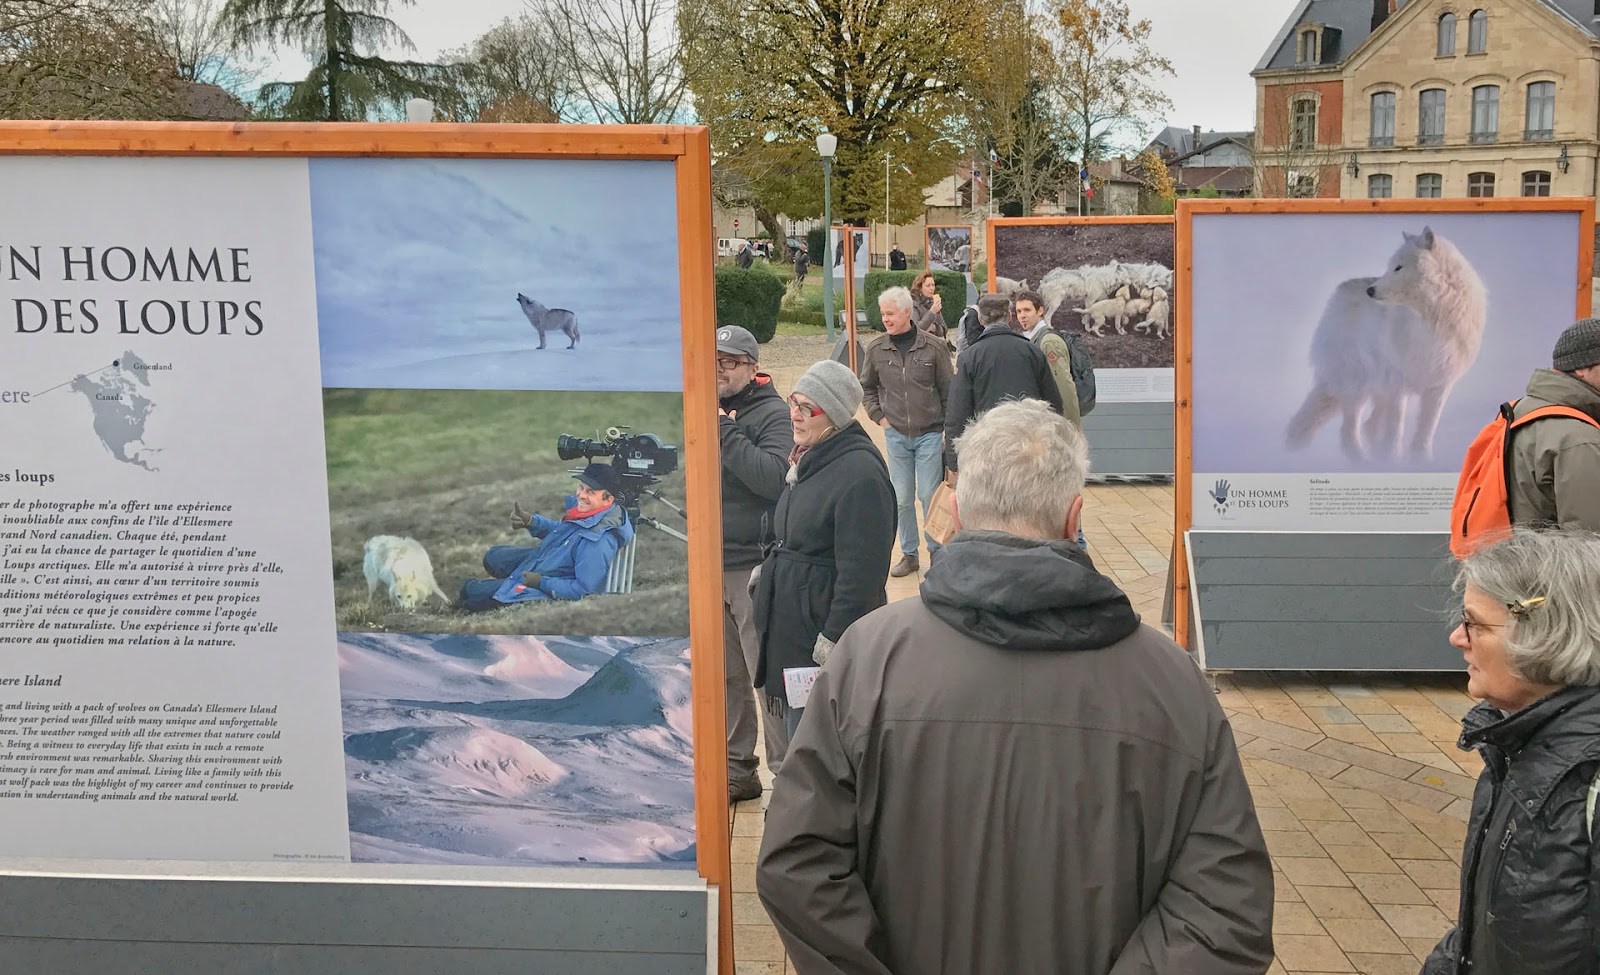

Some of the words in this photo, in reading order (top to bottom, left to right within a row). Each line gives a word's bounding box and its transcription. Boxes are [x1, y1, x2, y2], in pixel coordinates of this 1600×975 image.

[0, 246, 42, 281] N
[60, 246, 252, 283] HOMME
[12, 298, 99, 334] DES
[115, 299, 264, 336] LOUPS
[134, 362, 172, 371] Groenland
[0, 390, 30, 403] ere
[96, 392, 123, 401] Canada
[0, 473, 10, 482] es
[16, 469, 55, 486] loups
[1231, 490, 1246, 498] UN
[1249, 490, 1287, 498] HOMME
[13, 499, 26, 509] de
[27, 499, 95, 513] photographe
[98, 500, 117, 510] m’a
[121, 500, 150, 513] offert
[176, 502, 232, 514] expérience
[1239, 500, 1256, 508] DES
[1259, 500, 1289, 508] LOUPS
[3, 514, 65, 524] inoubliable
[91, 515, 129, 528] confins
[132, 515, 145, 525] de
[148, 515, 169, 526] l’île
[172, 516, 233, 527] d’Ellesmere
[0, 529, 27, 539] rand
[29, 529, 57, 539] Nord
[60, 530, 112, 540] canadien.
[116, 530, 157, 544] Chaque
[160, 531, 178, 542] été,
[181, 531, 227, 544] pendant
[1, 544, 22, 557] j’ai
[41, 544, 52, 554] la
[55, 545, 91, 555] chance
[94, 545, 107, 555] de
[109, 548, 157, 559] partager
[159, 546, 169, 556] le
[172, 546, 223, 559] quotidien
[227, 547, 257, 557] d’une
[4, 559, 35, 572] Loups
[38, 560, 90, 573] arctiques.
[94, 560, 115, 570] Elle
[118, 560, 137, 570] m’a
[140, 561, 184, 571] autorisé
[187, 561, 194, 571] à
[198, 562, 224, 572] vivre
[226, 563, 249, 575] près
[252, 562, 283, 573] d’elle,
[0, 574, 17, 584] ille
[34, 575, 60, 584] C’est
[62, 575, 92, 586] ainsi,
[143, 575, 167, 586] d’un
[171, 577, 220, 586] territoire
[223, 578, 259, 587] soumis
[44, 590, 129, 603] météorologiques
[132, 591, 178, 601] extrêmes
[181, 593, 192, 601] et
[193, 594, 214, 604] peu
[216, 593, 260, 605] propices
[2, 607, 22, 617] que
[23, 604, 43, 617] j’ai
[46, 605, 69, 614] vécu
[87, 608, 107, 618] que
[107, 606, 119, 618] je
[122, 605, 172, 615] considère
[214, 606, 257, 620] l’apogée
[38, 619, 51, 629] de
[54, 620, 115, 630] naturaliste.
[120, 620, 141, 630] Une
[144, 621, 200, 633] expérience
[202, 622, 212, 631] si
[212, 621, 240, 634] forte
[243, 622, 278, 635] qu’elle
[52, 634, 104, 647] quotidien
[128, 635, 170, 645] relation
[173, 636, 180, 645] à
[183, 635, 194, 645] la
[0, 678, 20, 686] ere
[24, 675, 62, 686] Island
[5, 701, 23, 710] and
[24, 702, 50, 713] living
[52, 702, 72, 711] with
[82, 702, 104, 714] pack
[106, 703, 117, 714] of
[118, 703, 146, 711] wolves
[163, 704, 203, 712] Canada’s
[205, 704, 247, 713] Ellesmere
[249, 705, 277, 713] Island
[18, 717, 39, 725] year
[40, 715, 70, 726] period
[89, 715, 114, 726] filled
[116, 716, 136, 724] with
[138, 719, 163, 727] many
[166, 717, 197, 728] unique
[199, 717, 217, 725] and
[219, 717, 278, 728] unforgettable
[22, 727, 38, 735] The
[40, 727, 76, 736] weather
[78, 728, 109, 739] ranged
[111, 728, 131, 737] with
[133, 728, 146, 737] all
[147, 729, 161, 737] the
[204, 729, 222, 738] that
[256, 730, 281, 739] could
[7, 740, 32, 751] Being
[42, 741, 74, 749] witness
[87, 741, 126, 752] everyday
[128, 741, 143, 752] life
[145, 741, 164, 750] that
[166, 742, 190, 750] exists
[192, 742, 201, 750] in
[204, 742, 224, 751] such
[15, 753, 71, 761] environment
[93, 753, 145, 762] remarkable.
[148, 754, 183, 765] Sharing
[185, 754, 202, 763] this
[204, 755, 260, 764] environment
[262, 756, 282, 764] with
[24, 790, 33, 798] in
[36, 790, 99, 802] understanding
[101, 791, 136, 800] animals
[138, 792, 157, 800] and
[158, 792, 172, 800] the
[174, 792, 209, 801] natural
[211, 793, 239, 801] world.
